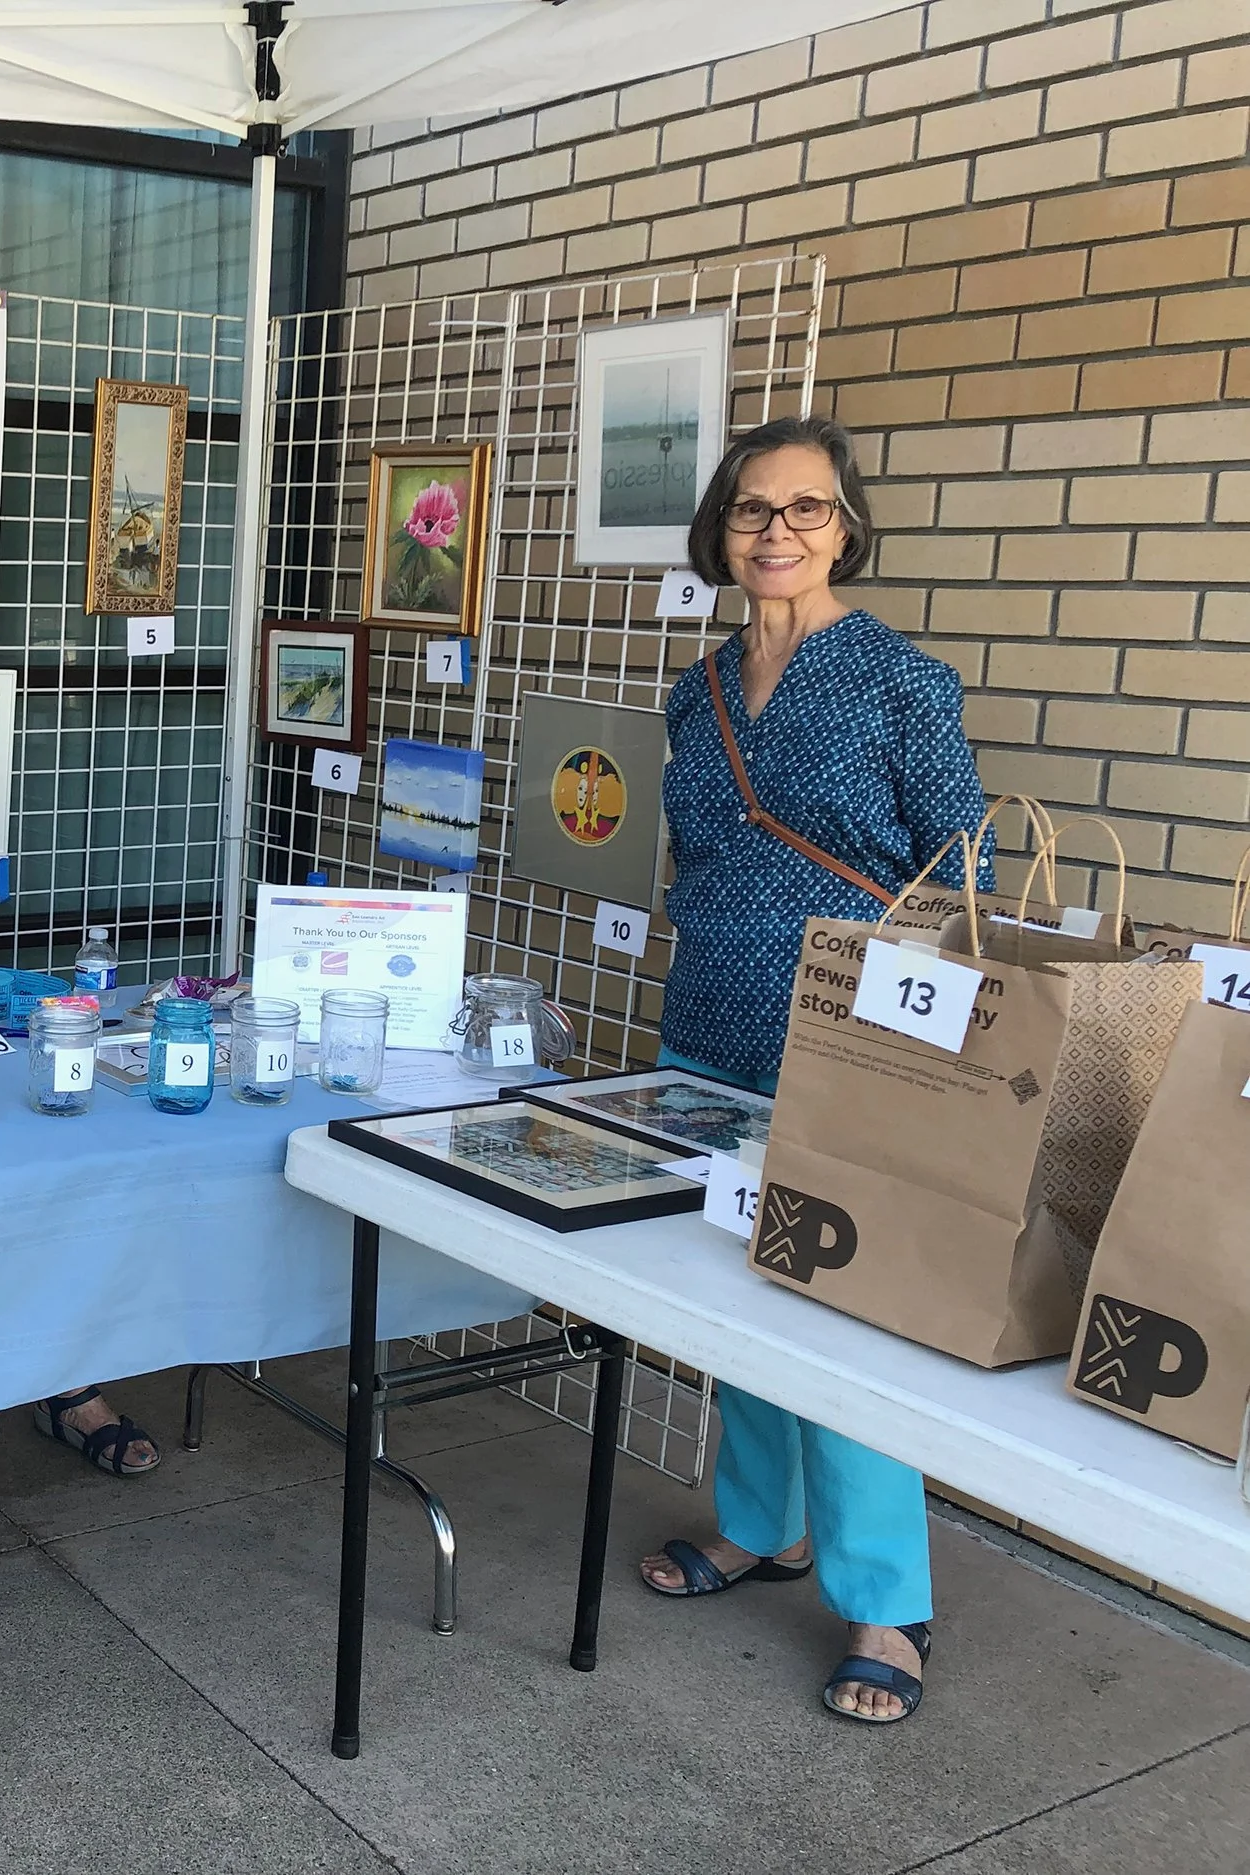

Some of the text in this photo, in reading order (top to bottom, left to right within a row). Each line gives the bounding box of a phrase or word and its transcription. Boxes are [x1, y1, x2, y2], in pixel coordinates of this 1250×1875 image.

[682, 586, 694, 604] 9
[147, 629, 156, 644] 5
[444, 655, 451, 671] 7
[331, 765, 341, 780] 6
[293, 926, 428, 943] Thank You to Our Sponsors
[612, 920, 630, 940] 10
[898, 977, 935, 1015] 13
[799, 992, 849, 1022] stop
[504, 1039, 524, 1056] 18
[182, 1055, 193, 1072] 9
[269, 1054, 287, 1071] 10
[71, 1063, 80, 1080] 8
